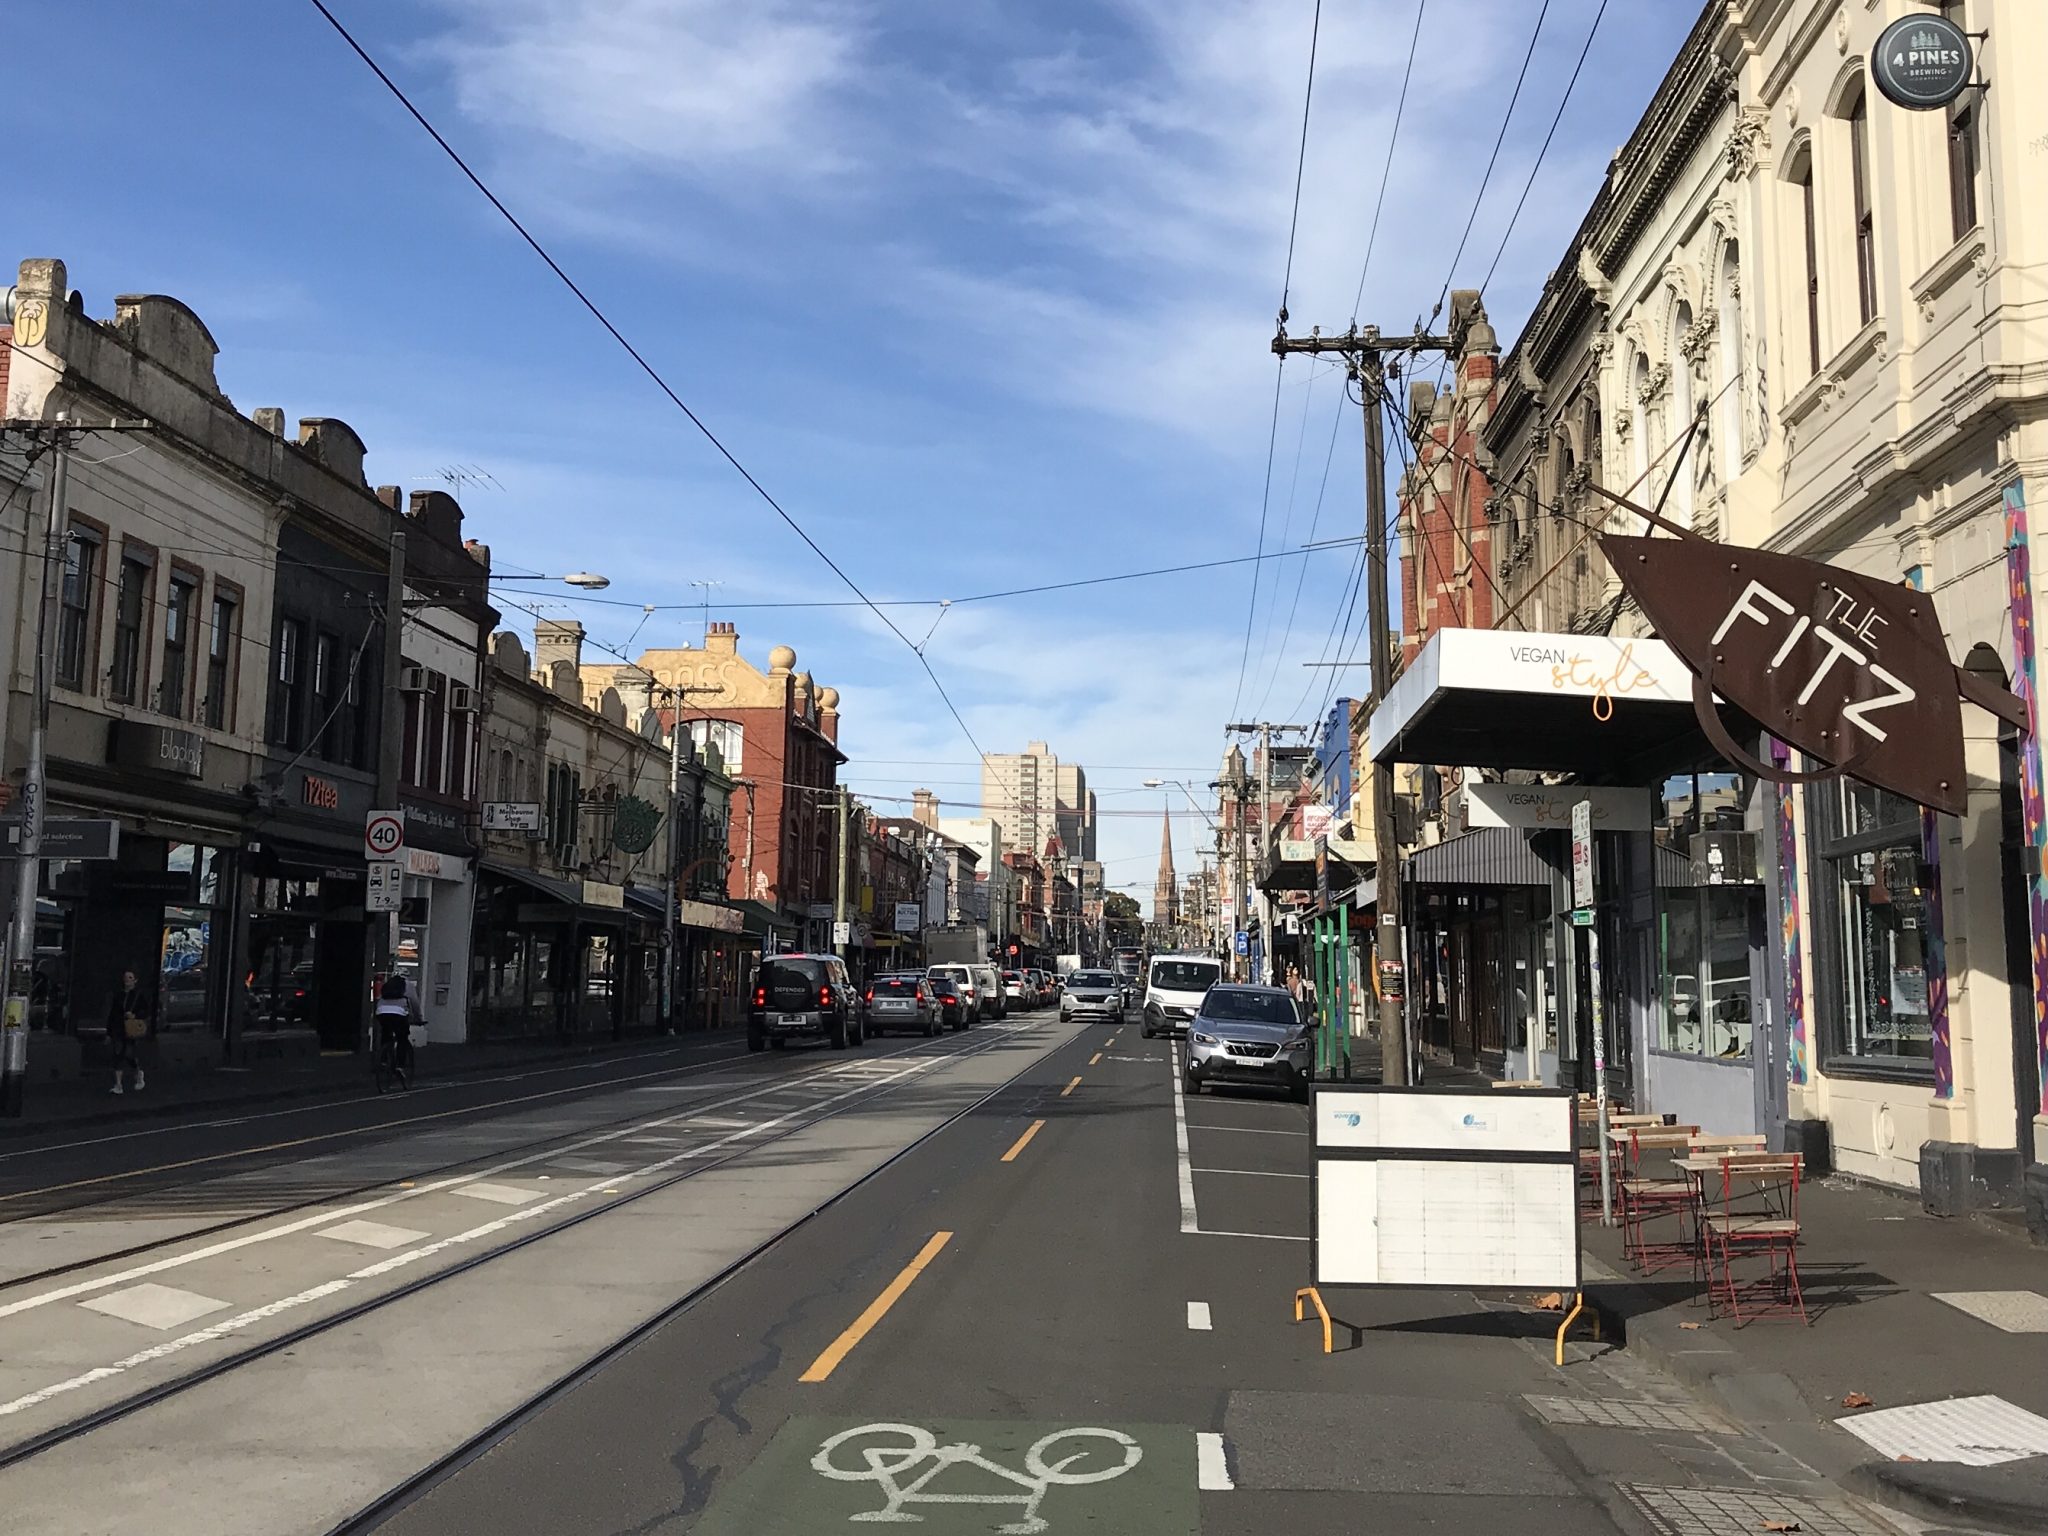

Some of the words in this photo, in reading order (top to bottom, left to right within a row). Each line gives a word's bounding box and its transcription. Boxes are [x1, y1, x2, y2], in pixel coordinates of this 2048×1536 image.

[1892, 52, 1905, 67] 4
[1909, 50, 1960, 66] PINES
[1909, 68, 1947, 76] BREWING
[1825, 586, 1889, 650] THE
[1510, 646, 1565, 664] VEGAN
[1711, 579, 1916, 743] FITZ
[1551, 642, 1659, 721] style
[305, 775, 338, 808] T2tea
[1506, 794, 1545, 805] VEGAN
[372, 828, 395, 844] 40
